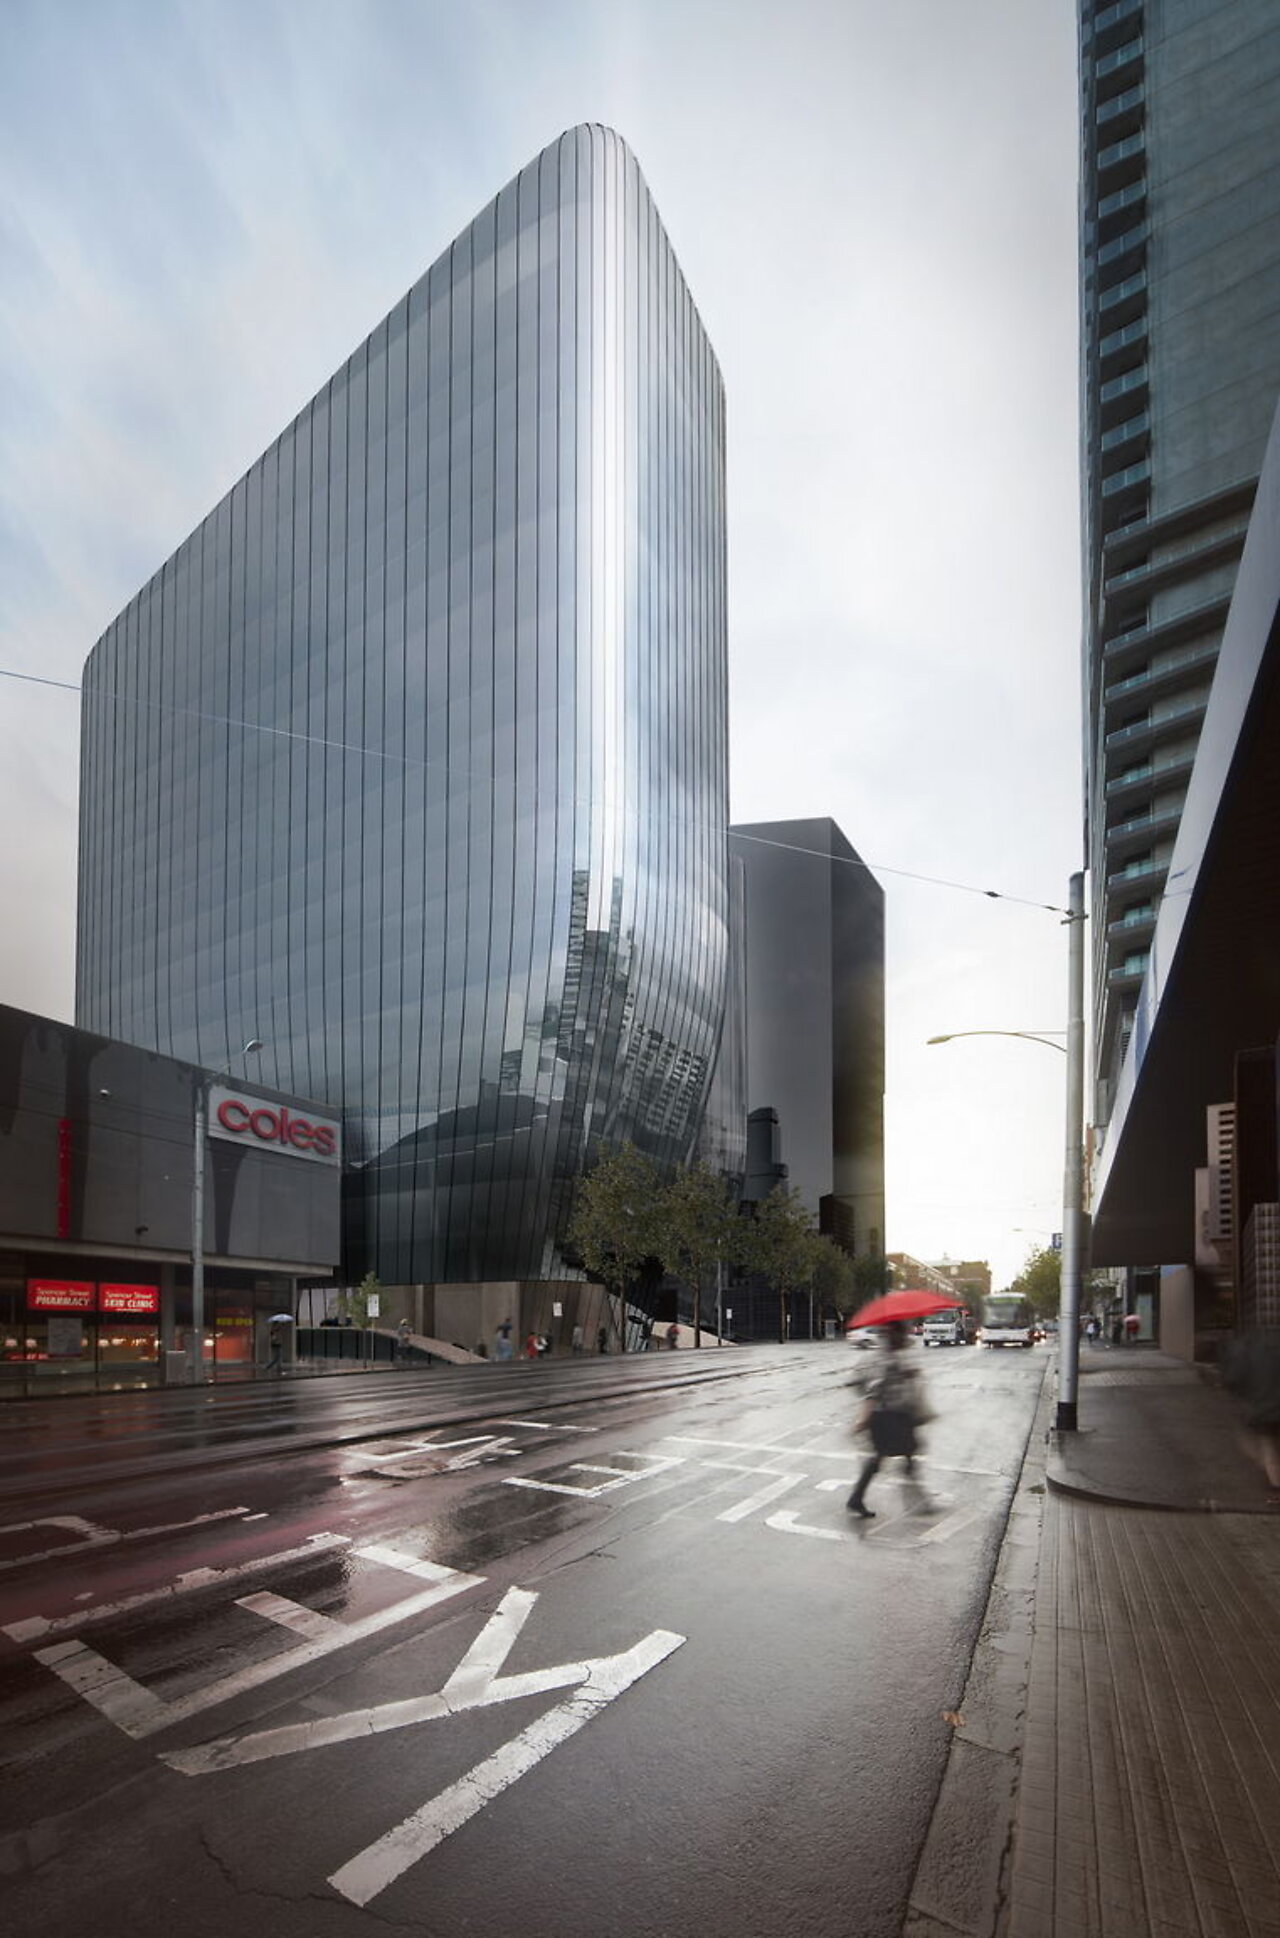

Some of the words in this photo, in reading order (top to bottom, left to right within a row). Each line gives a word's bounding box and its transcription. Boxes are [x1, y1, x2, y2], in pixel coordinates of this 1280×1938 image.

[218, 1100, 336, 1156] coles
[35, 1296, 90, 1306] PHARMACY
[127, 1300, 154, 1309] CLINIC
